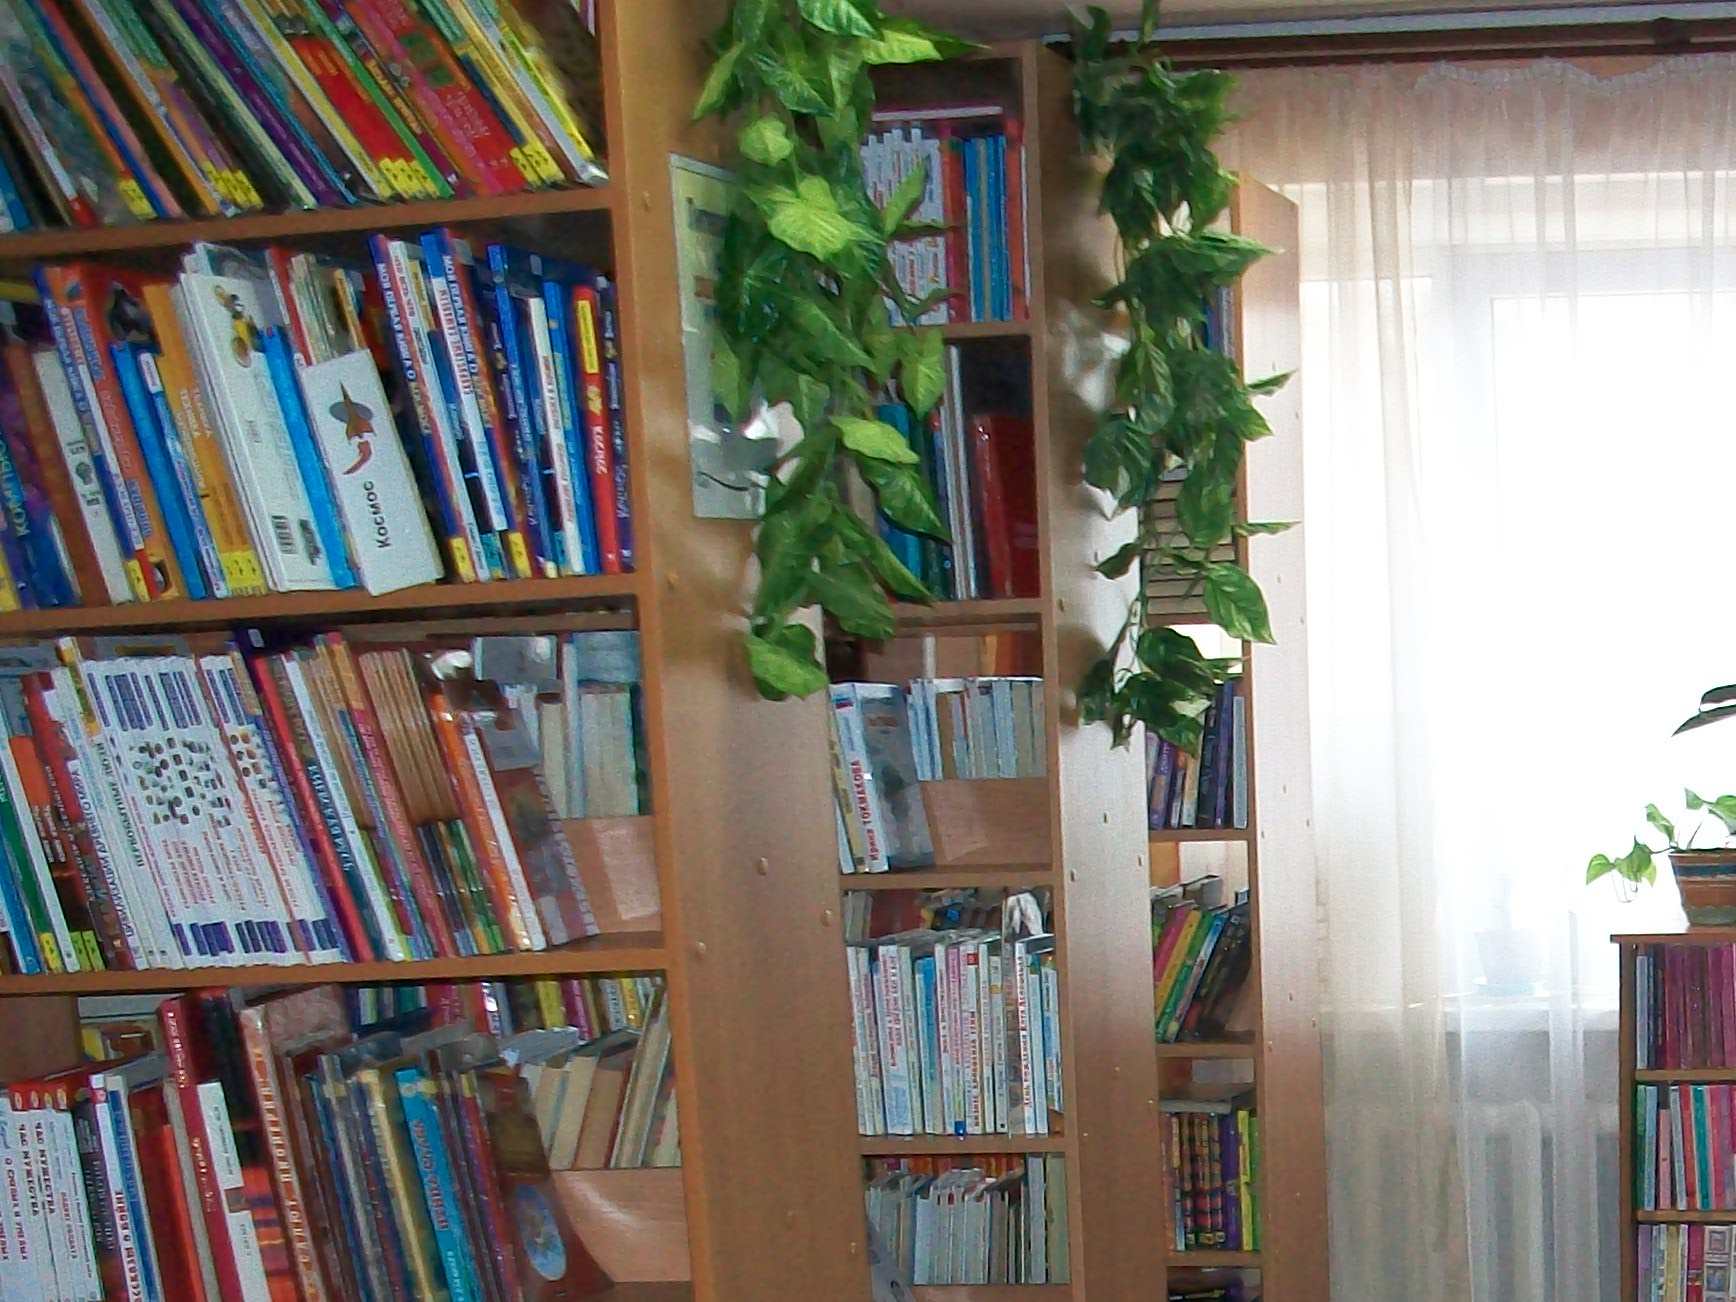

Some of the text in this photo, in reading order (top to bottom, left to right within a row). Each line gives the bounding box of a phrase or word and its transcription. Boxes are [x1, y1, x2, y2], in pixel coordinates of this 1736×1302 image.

[360, 479, 393, 549] Космос
[70, 768, 135, 938] ЦИВИЛИЗАЦИИ ДРЕВНЕГО МИРА
[850, 758, 879, 861] Ирина ТОКМАКОВА
[18, 1123, 39, 1217] ЧАС МУЖЕСТВА
[34, 1122, 55, 1215] ЧАС МУЖЕСТВА
[111, 1188, 130, 1231] ВОЙНЕ
